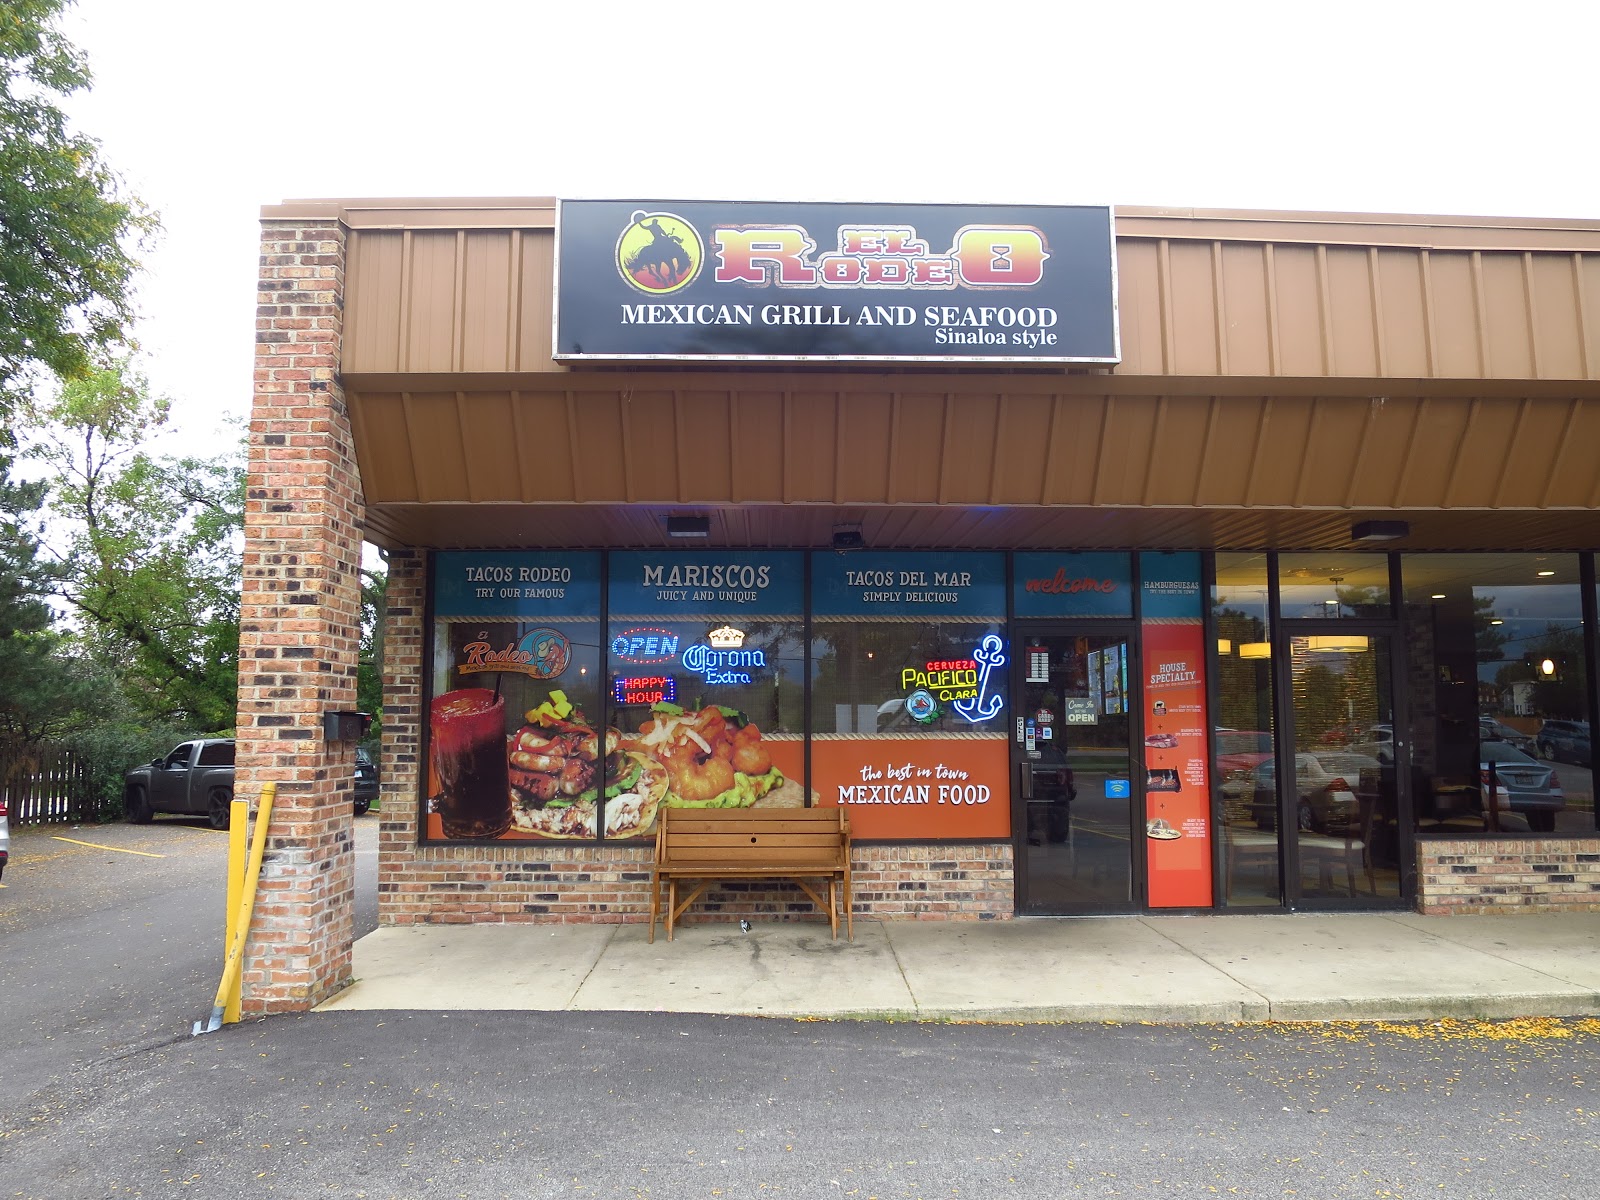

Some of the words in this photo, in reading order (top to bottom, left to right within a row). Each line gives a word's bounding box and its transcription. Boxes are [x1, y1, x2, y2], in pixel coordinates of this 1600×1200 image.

[846, 230, 924, 255] EL
[621, 305, 755, 326] MEXICAN
[760, 305, 849, 326] GRILL
[855, 306, 917, 327] AND
[924, 307, 1058, 329] SEAFOOD
[935, 328, 1007, 346] Sinaloa
[1012, 329, 1058, 347] style
[466, 567, 513, 583] TACOS
[519, 567, 571, 583] RODEO
[643, 565, 770, 588] MARISCOS
[847, 571, 894, 587] TACOS
[900, 571, 928, 587] DEL
[934, 572, 971, 587] MAR
[1026, 568, 1118, 594] welcome
[1144, 581, 1199, 589] HAMBURGUESAS
[476, 588, 495, 598] TRY
[500, 588, 520, 598] OUR
[525, 588, 565, 599] FAMOUS
[656, 591, 687, 601] JUICY
[692, 591, 715, 601] AND
[719, 591, 757, 603] UNIQUE
[863, 592, 901, 602] SIMPLY
[906, 592, 958, 603] DELICIOUS
[463, 641, 534, 666] Rodeo
[612, 636, 679, 656] OPEN
[683, 645, 766, 673] Corona
[926, 660, 977, 670] CERVEZA
[1159, 663, 1186, 673] HOUSE
[624, 677, 666, 689] HAPPY
[706, 669, 751, 684] Extra
[902, 669, 978, 689] PACIFICO
[1150, 671, 1196, 684] SPECIALTY
[627, 691, 664, 703] HOUR
[939, 689, 978, 701] CLARA
[1068, 713, 1095, 722] OPEN
[859, 765, 882, 782] the
[887, 762, 915, 781] best
[917, 766, 932, 778] in
[935, 763, 969, 781] town
[838, 785, 930, 804] MEXICAN
[938, 785, 991, 805] FOOD
